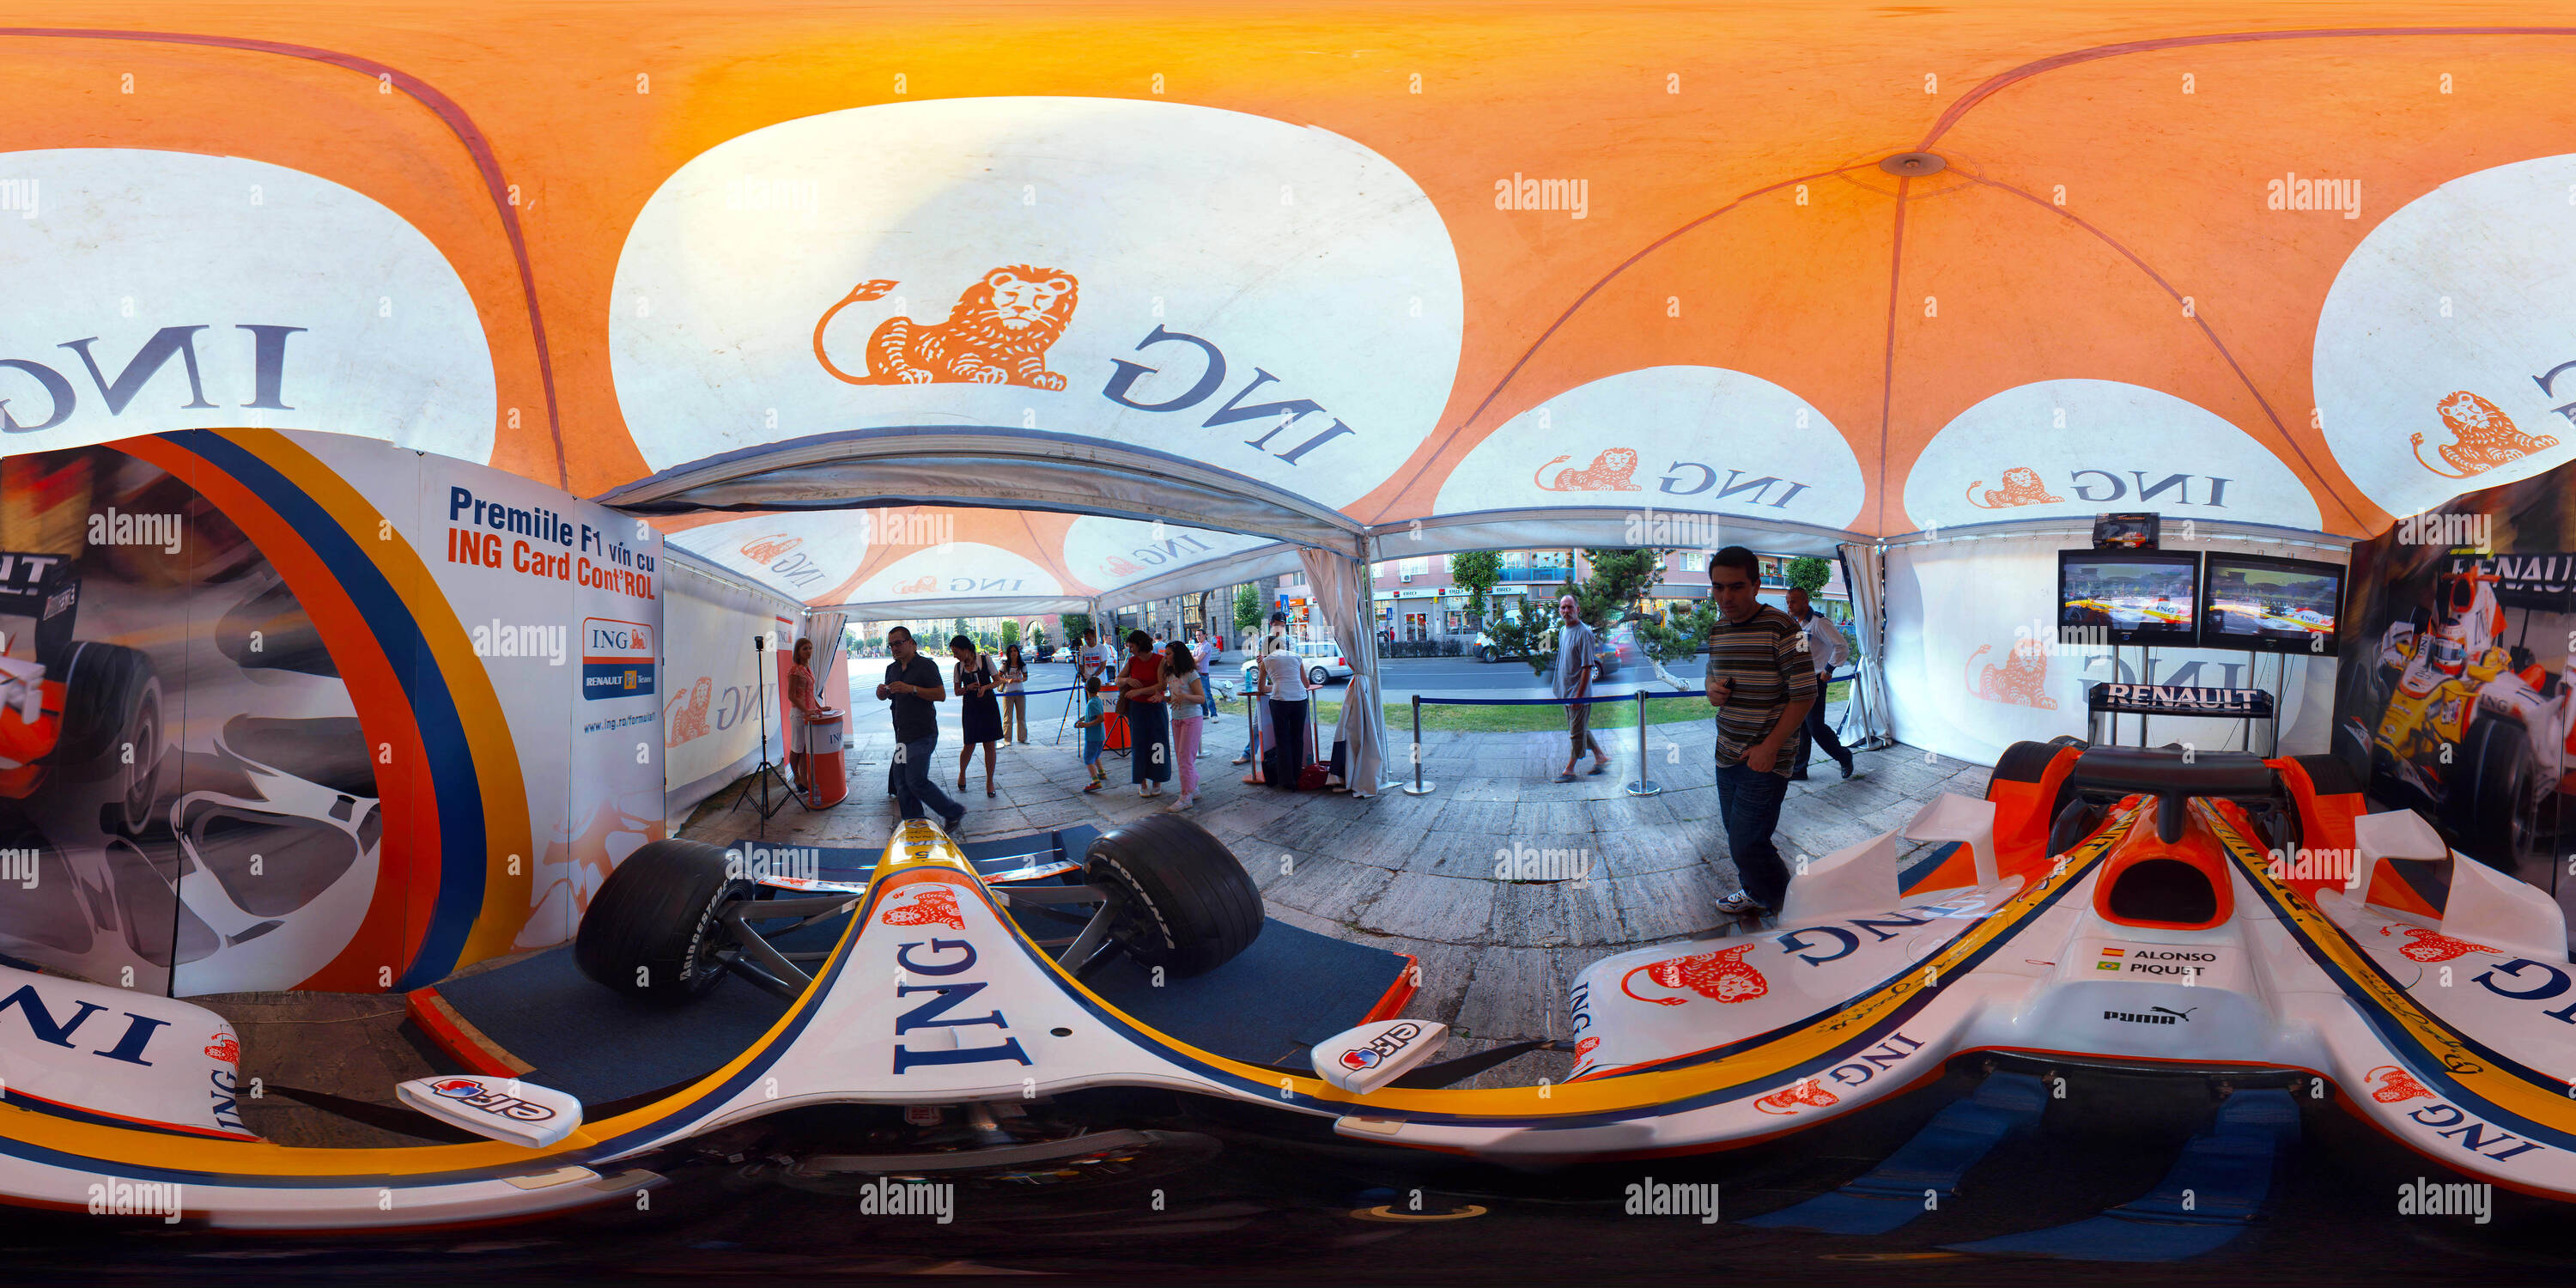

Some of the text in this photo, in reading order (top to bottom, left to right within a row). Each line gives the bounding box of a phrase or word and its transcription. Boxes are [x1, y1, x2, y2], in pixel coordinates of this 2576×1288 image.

[447, 527, 502, 569] ING
[513, 539, 570, 581] Card
[449, 485, 574, 548] Premiile
[580, 523, 603, 557] F1
[636, 553, 654, 573] cu
[592, 629, 629, 650] ING
[586, 676, 623, 686] RENAULT
[2106, 683, 2257, 710] RENAULT
[2135, 951, 2216, 962] ALONSO
[893, 938, 1036, 1075] ING
[1829, 1032, 1925, 1087] ING
[2408, 1104, 2546, 1162] ING
